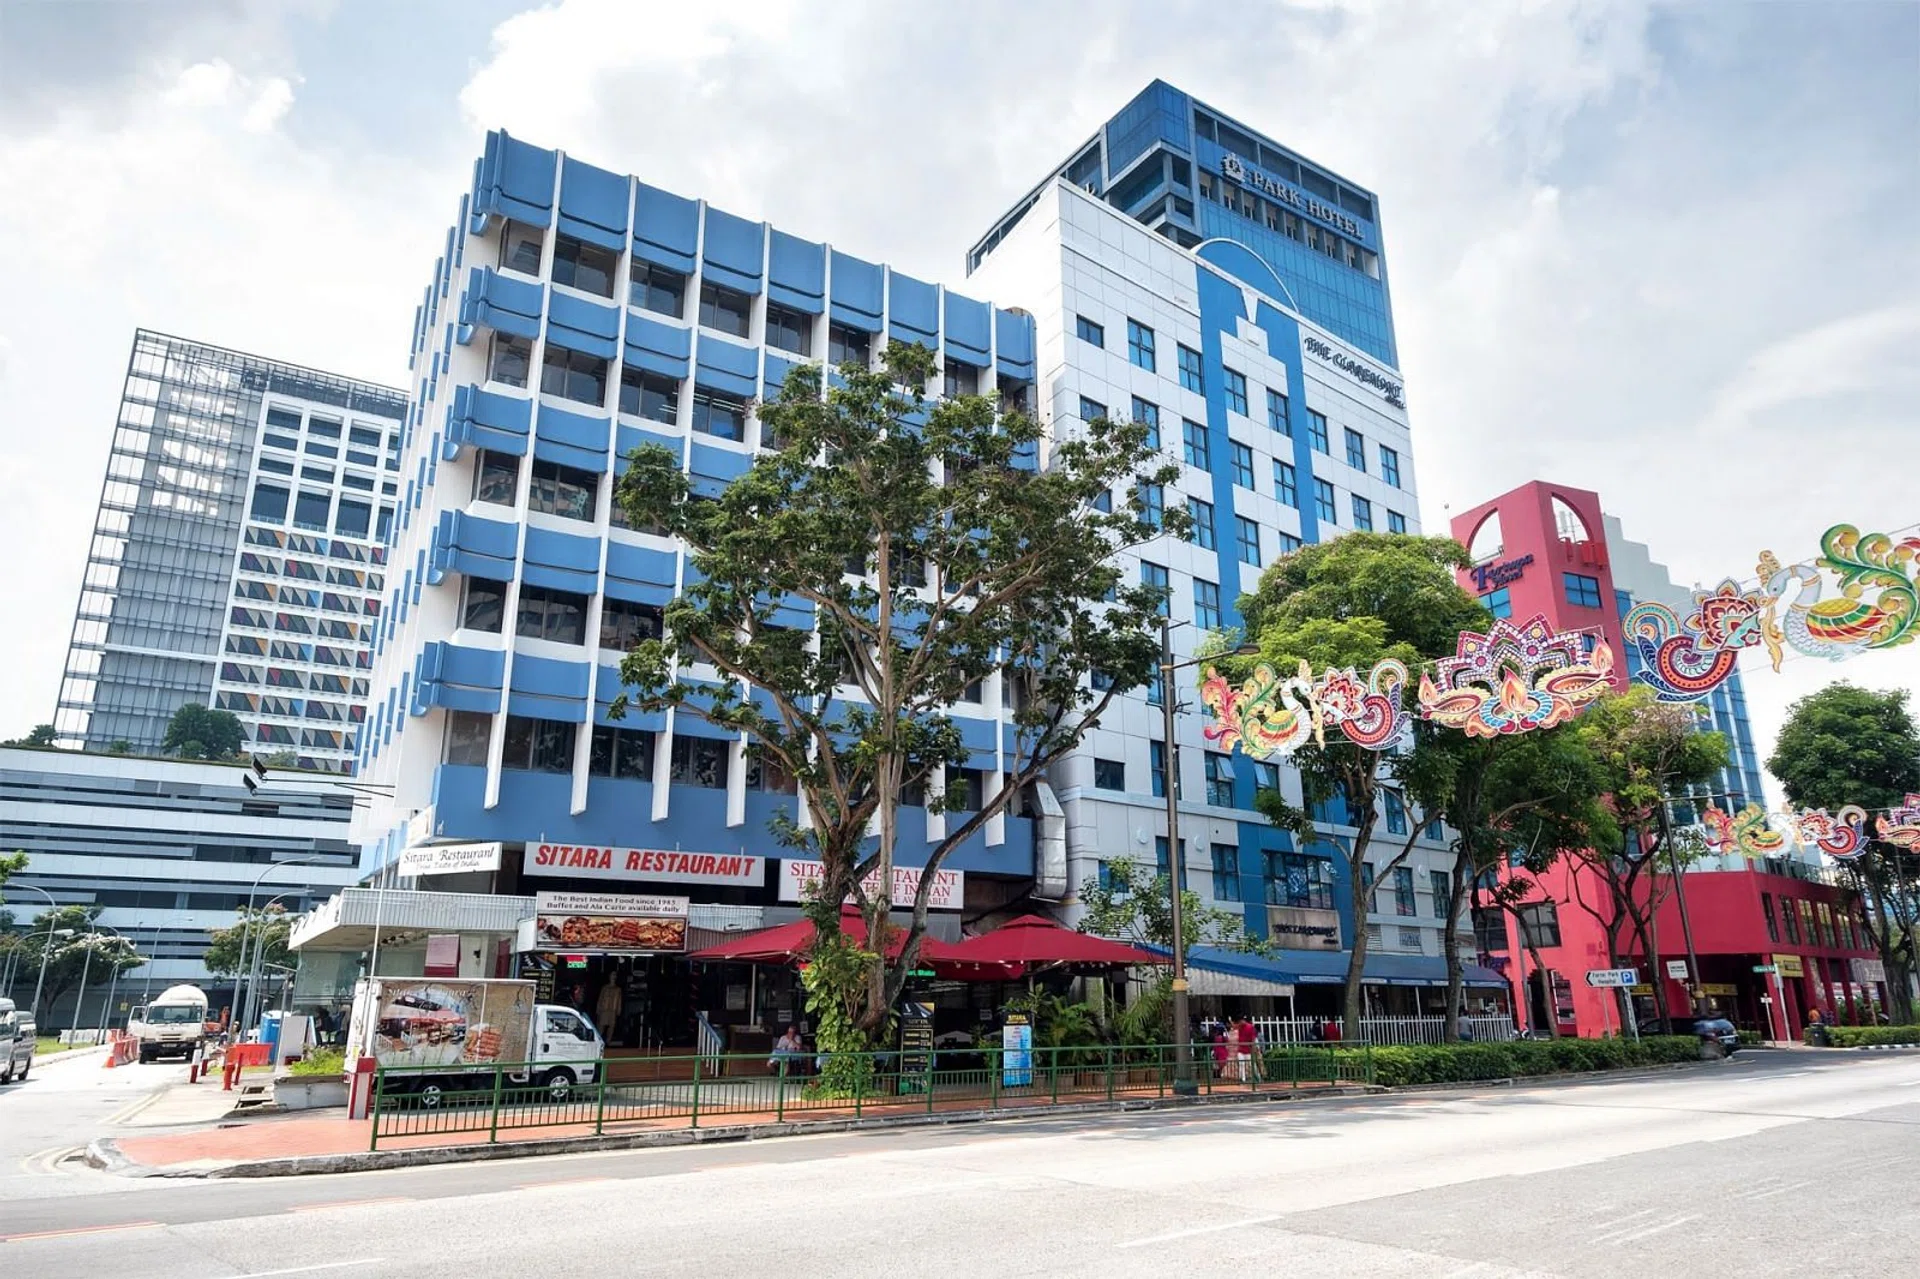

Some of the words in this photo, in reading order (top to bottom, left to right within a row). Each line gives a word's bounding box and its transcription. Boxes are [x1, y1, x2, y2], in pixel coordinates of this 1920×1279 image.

[1252, 170, 1301, 206] PARK
[1308, 198, 1365, 240] HOTEL
[1305, 337, 1331, 361] THE
[403, 851, 433, 864] Sitara
[440, 846, 495, 861] Restaurant
[535, 844, 612, 869] SITARA
[625, 850, 756, 877] RESTAURANT
[570, 895, 588, 903] Best
[574, 902, 589, 910] and
[661, 905, 680, 913] daily
